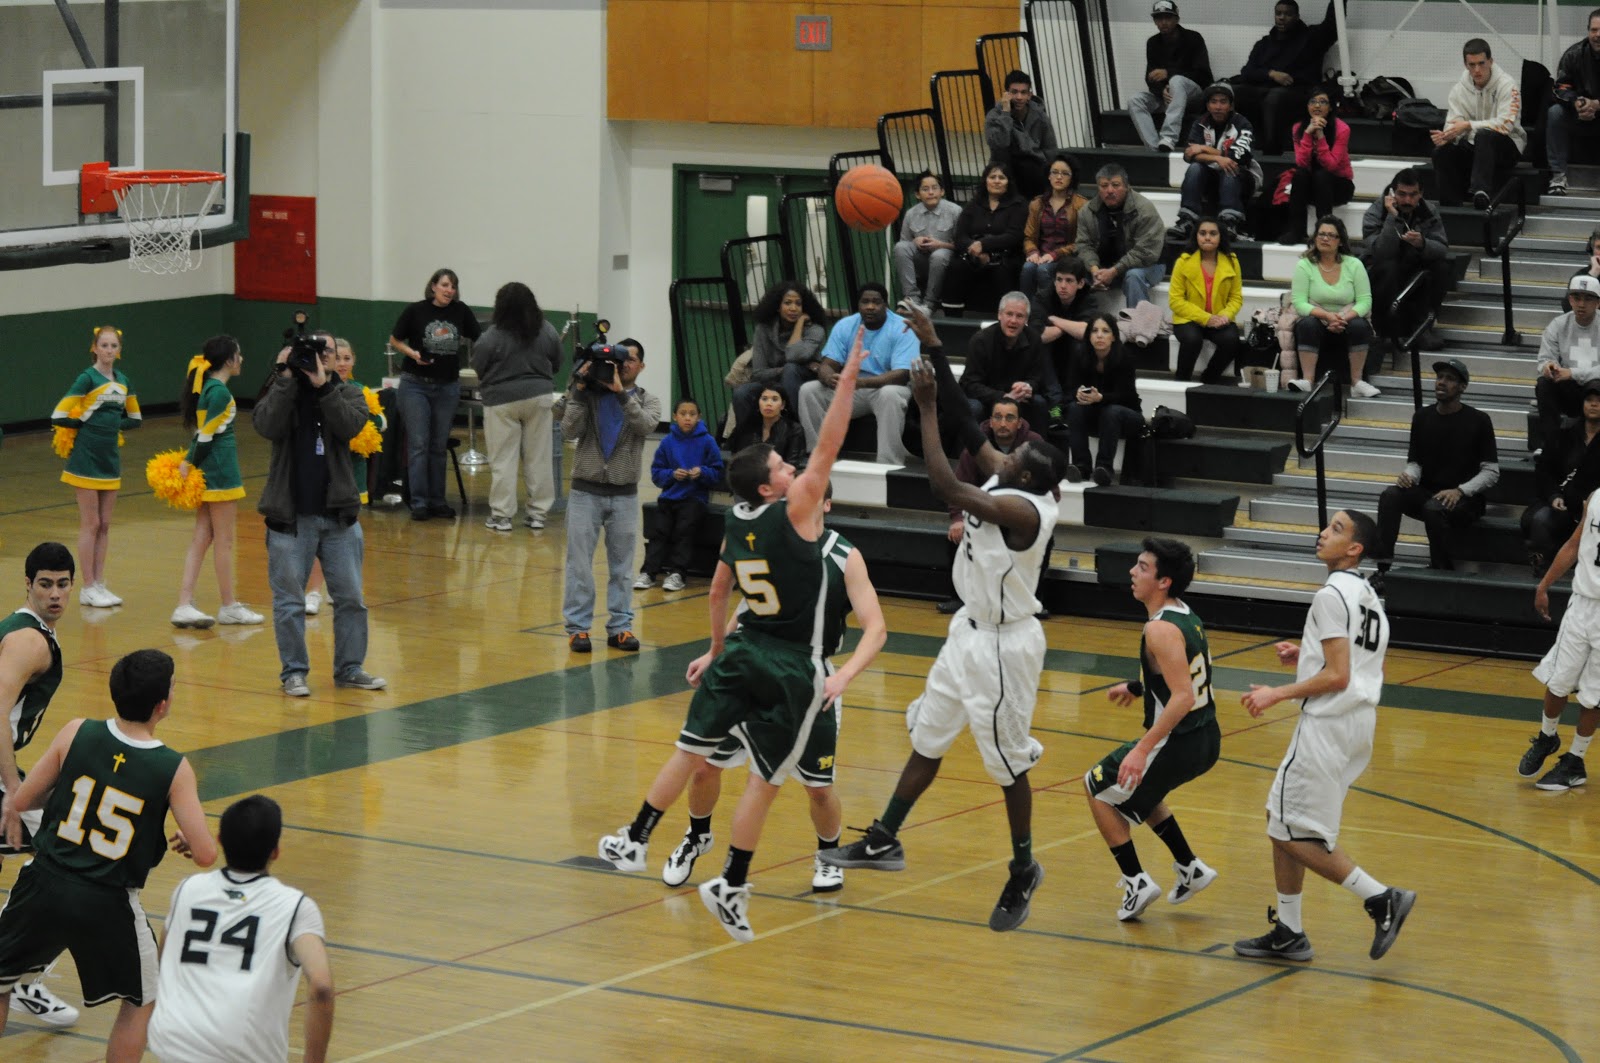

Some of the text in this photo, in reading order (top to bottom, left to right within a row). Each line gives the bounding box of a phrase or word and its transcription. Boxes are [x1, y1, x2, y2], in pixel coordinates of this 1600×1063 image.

[800, 20, 828, 44] EXIT
[735, 559, 781, 616] 5
[1354, 604, 1381, 653] 30
[1188, 651, 1214, 711] 2
[57, 775, 145, 860] 15
[180, 908, 260, 971] 24
